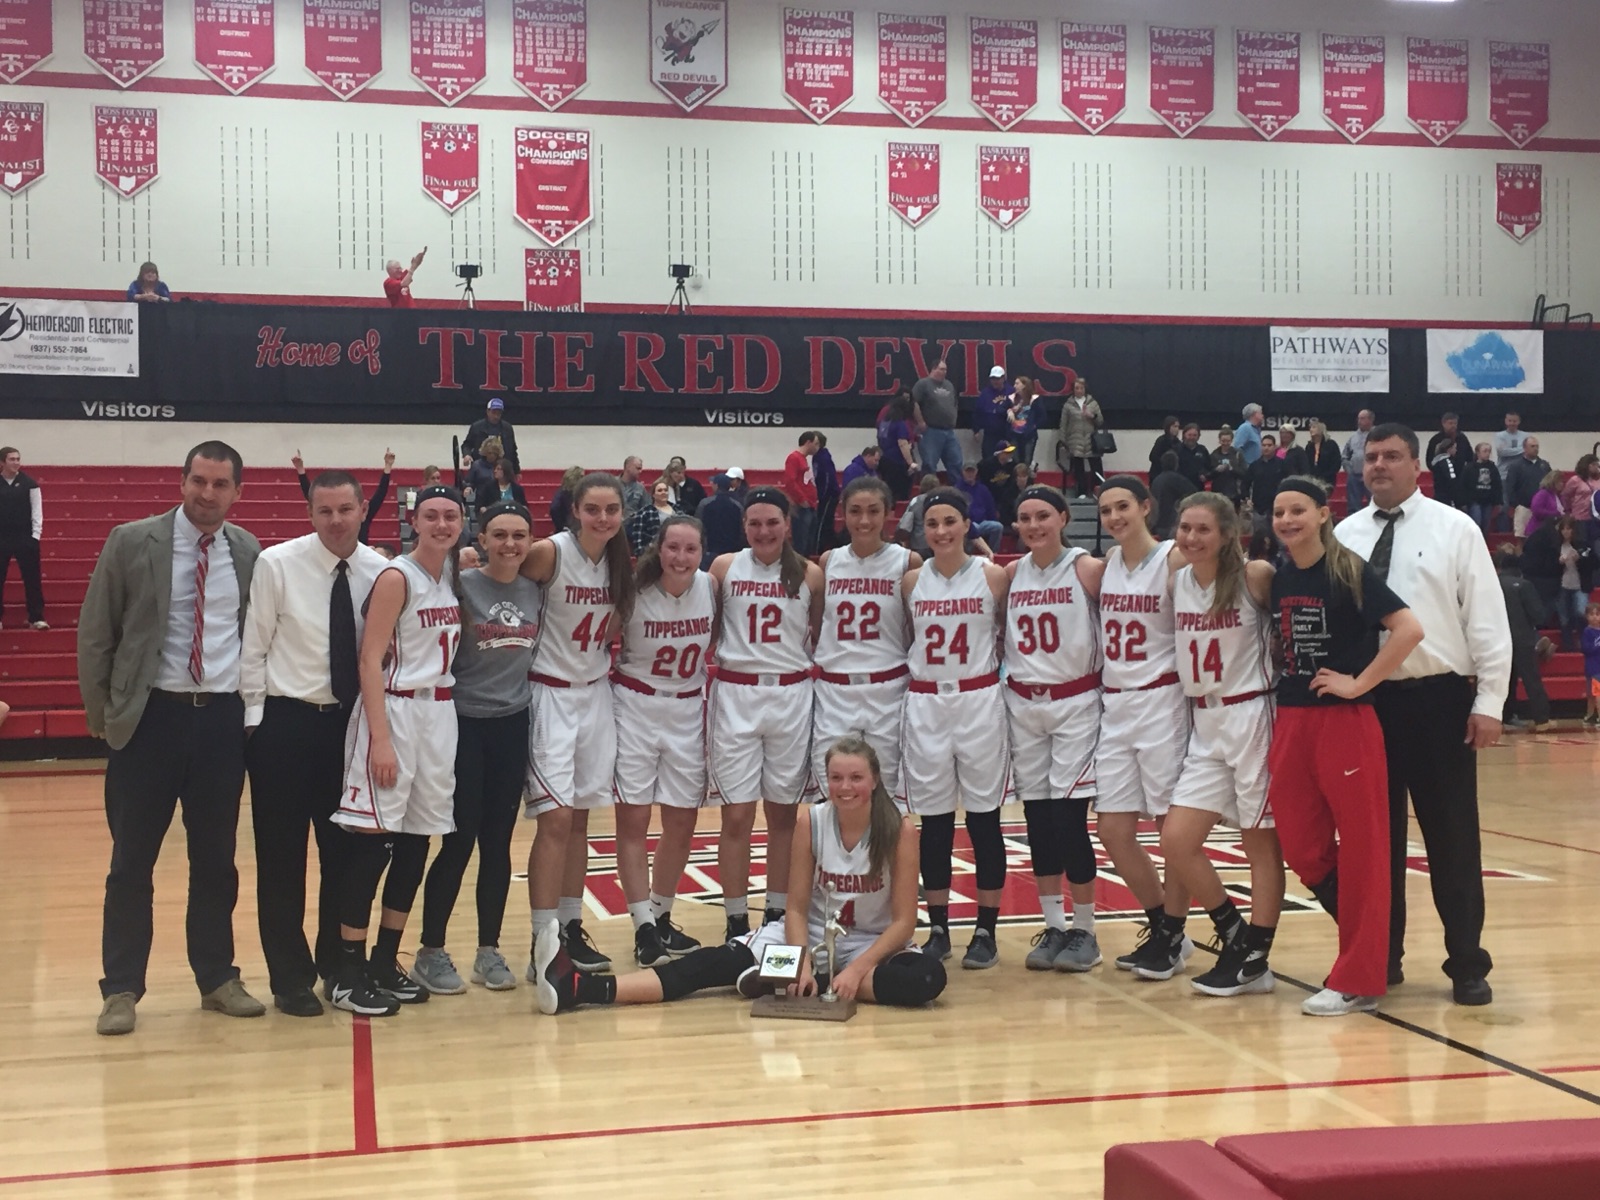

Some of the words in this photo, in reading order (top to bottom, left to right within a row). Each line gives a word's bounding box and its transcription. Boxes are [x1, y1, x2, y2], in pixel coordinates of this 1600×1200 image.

[412, 2, 483, 18] CHAMPIONS
[515, 7, 584, 23] CHAMPIONS
[785, 8, 852, 24] FOOTBALL
[880, 14, 944, 29] BASKETBALL
[972, 19, 1035, 33] BASKETBALL
[786, 24, 852, 38] CHAMPIONS
[880, 28, 945, 44] CHAMPIONS
[1062, 23, 1125, 38] BASEBALL
[1151, 27, 1212, 42] TRACK
[972, 33, 1036, 48] CHAMPIONS
[1063, 37, 1125, 52] CHAMPIONS
[1239, 31, 1298, 45] TRACK
[1325, 35, 1383, 49] WRESTLING
[1409, 38, 1426, 48] ALL
[1152, 42, 1212, 56] CHAMPIONS
[1239, 44, 1298, 58] CHAMPIONS
[1325, 50, 1384, 63] CHAMPIONS
[1409, 52, 1466, 65] CHAMPIONS
[1492, 57, 1548, 70] CHAMPIONS
[660, 72, 680, 81] RED
[682, 73, 717, 83] DEVILS
[0, 110, 41, 124] TATE
[122, 109, 154, 117] COUNTRY
[97, 116, 155, 128] STATE
[431, 123, 468, 132] SOCCER
[423, 130, 477, 144] STATE
[516, 129, 588, 145] SOCCER
[517, 145, 588, 160] CHAMPIONS
[890, 143, 936, 152] BASKETBALL
[530, 158, 575, 166] CONFERENCE
[890, 151, 938, 163] STATE
[982, 154, 1028, 166] STATE
[0, 158, 41, 171] NALIST
[99, 160, 156, 174] FINALIST
[425, 174, 450, 187] FINAL
[453, 177, 477, 188] FOUR
[1498, 171, 1540, 180] STATE
[538, 184, 568, 192] DISTRICT
[890, 192, 913, 203] FINAL
[916, 193, 938, 204] FOUR
[983, 195, 1005, 207] FINAL
[1008, 196, 1029, 207] FOUR
[536, 204, 570, 212] REGIONAL
[534, 250, 570, 258] SOCCER
[526, 257, 579, 270] STATE
[528, 300, 552, 312] FINAL
[557, 302, 579, 312] FOUR
[25, 316, 84, 333] HENDERSON
[89, 318, 134, 335] ELECTRIC
[29, 334, 70, 342] Residential
[86, 336, 130, 344] Commercial
[1272, 336, 1388, 356] PATHWAYS
[30, 345, 51, 354] (937)
[256, 325, 341, 368] Home
[348, 328, 382, 375] of
[418, 326, 595, 393] THE
[618, 331, 782, 395] RED
[1289, 374, 1318, 383] DUSTY
[81, 401, 176, 418] Visitors
[704, 409, 784, 424] Visitors
[731, 580, 800, 600] TIPPECAN
[828, 578, 896, 596] TIPPECANOE
[565, 586, 614, 605] TIPPECA
[1010, 586, 1073, 609] TIPPECANOE
[914, 598, 984, 618] TIPPECANOE
[1100, 593, 1161, 613] IPPECANOE
[417, 606, 460, 628] TIPPECA
[747, 603, 782, 644] 12
[837, 600, 880, 641] 22
[1176, 609, 1243, 632] TIPPECANOE
[644, 616, 710, 638] TIPPECANOE
[1017, 612, 1060, 655] 30
[925, 623, 969, 665] 24
[1105, 619, 1147, 662] 32
[651, 643, 701, 679] 20
[1189, 638, 1223, 683] 14
[350, 786, 361, 802] T
[838, 900, 856, 927] 4
